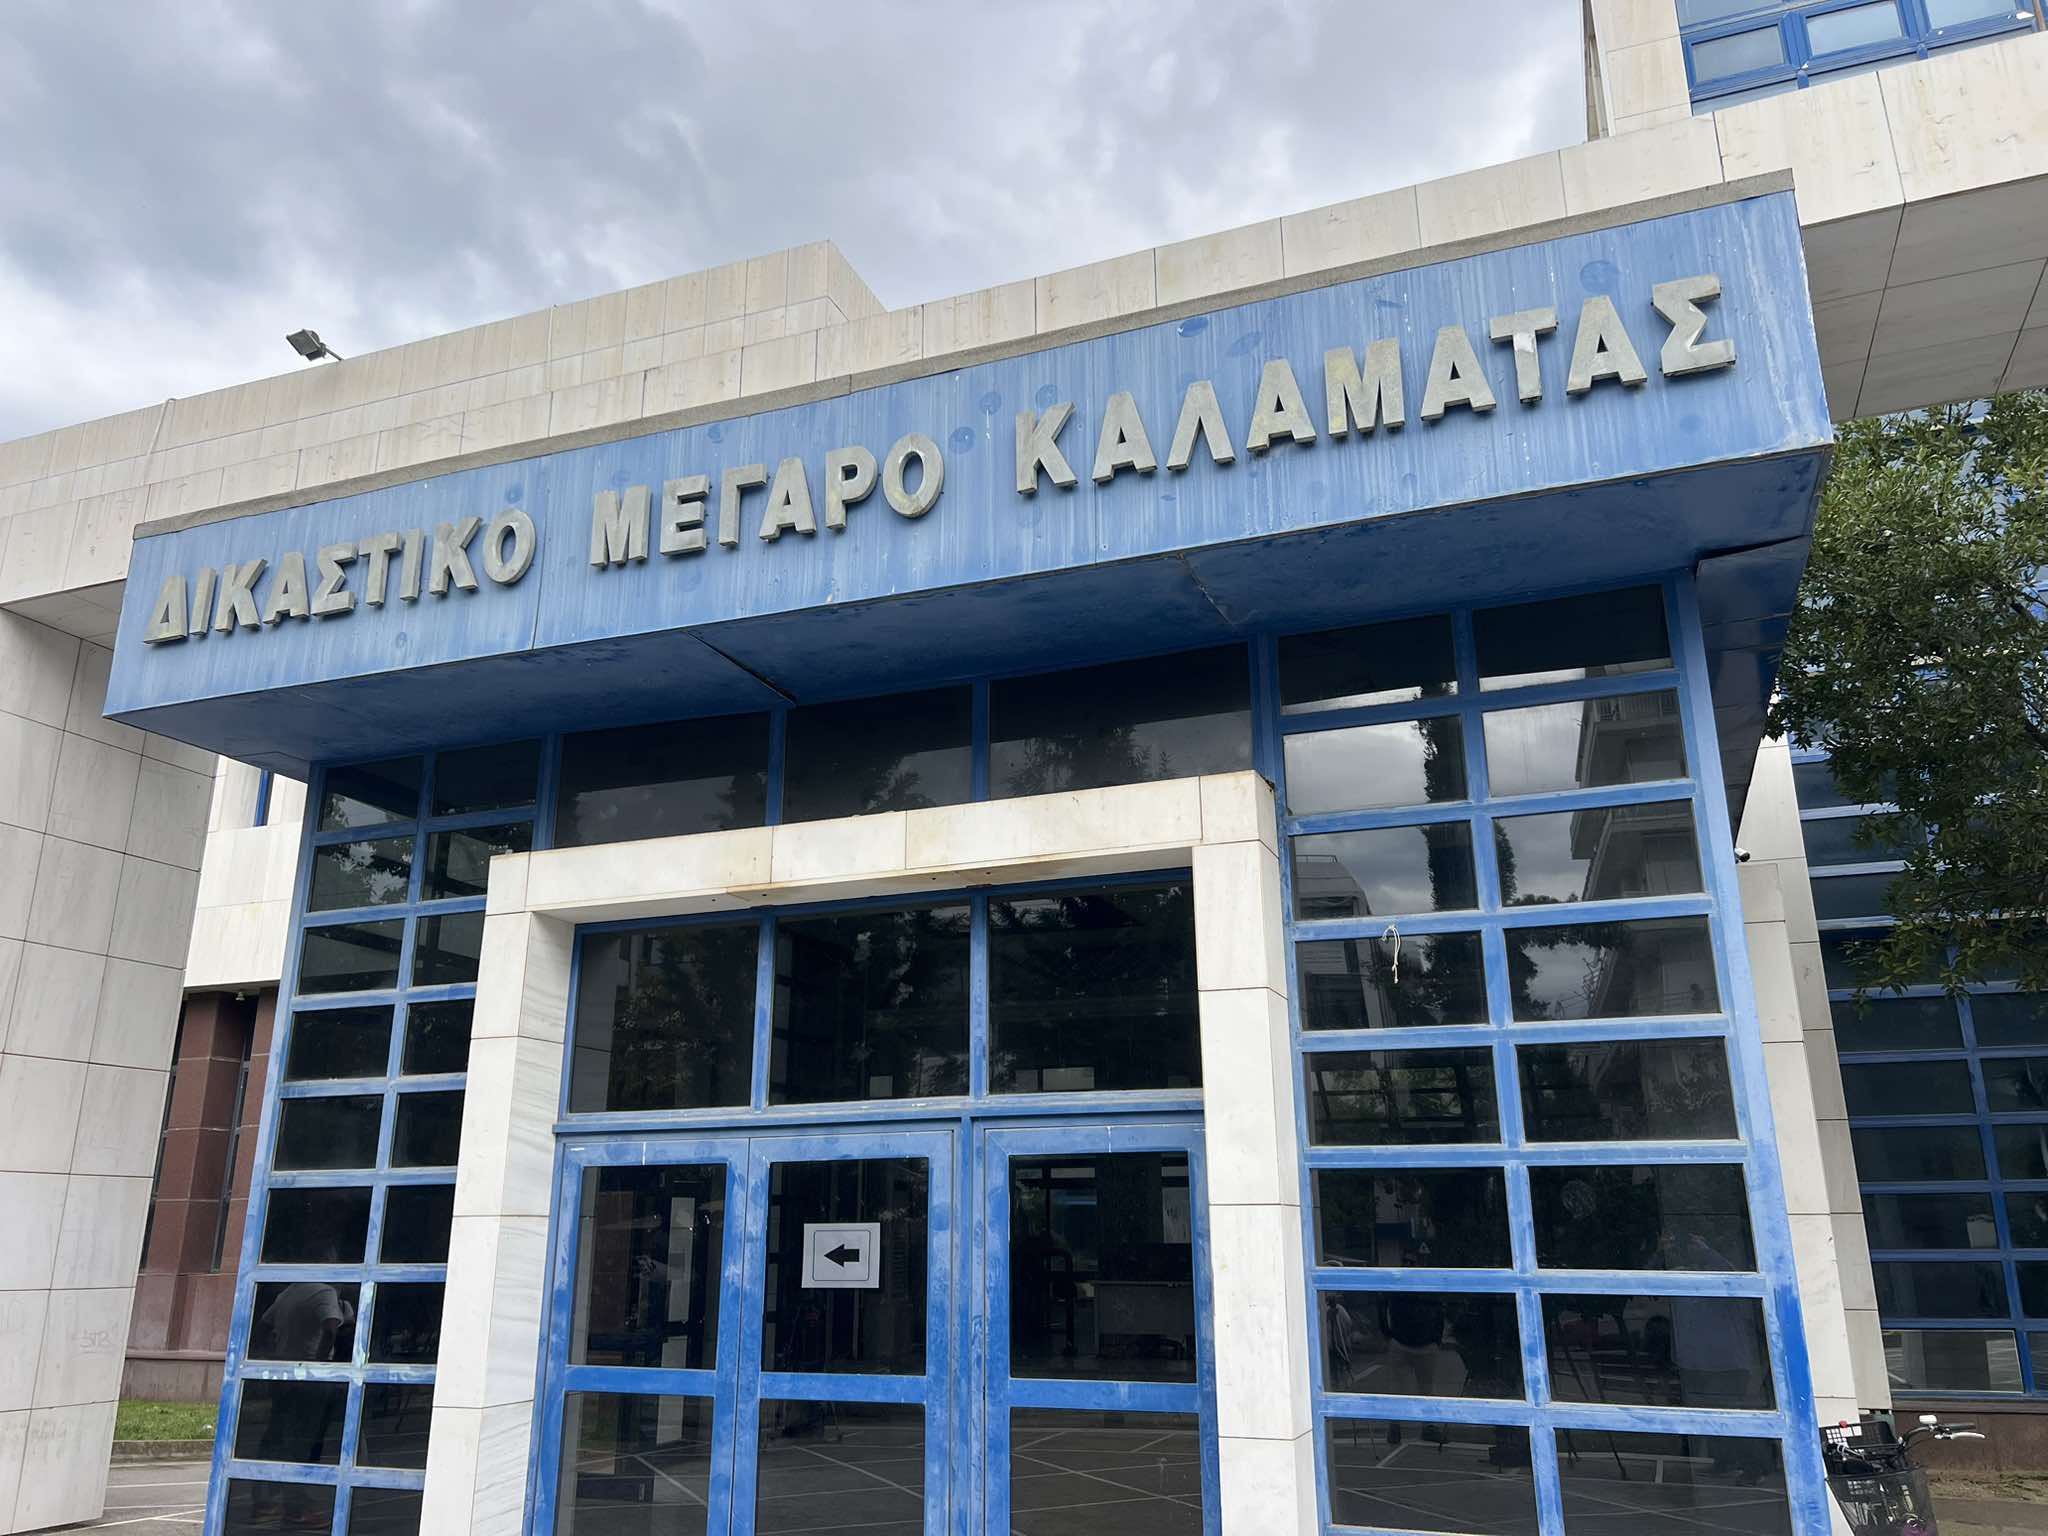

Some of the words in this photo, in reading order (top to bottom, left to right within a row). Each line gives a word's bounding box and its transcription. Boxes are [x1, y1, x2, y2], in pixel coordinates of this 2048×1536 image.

[143, 507, 536, 645] ΔΙΚΑΣΤΙΚΟ
[590, 432, 945, 568] ΜΕΓΑΡΟ
[1014, 273, 1737, 495] ΚΑΛΑΜΑΤΑΣ
